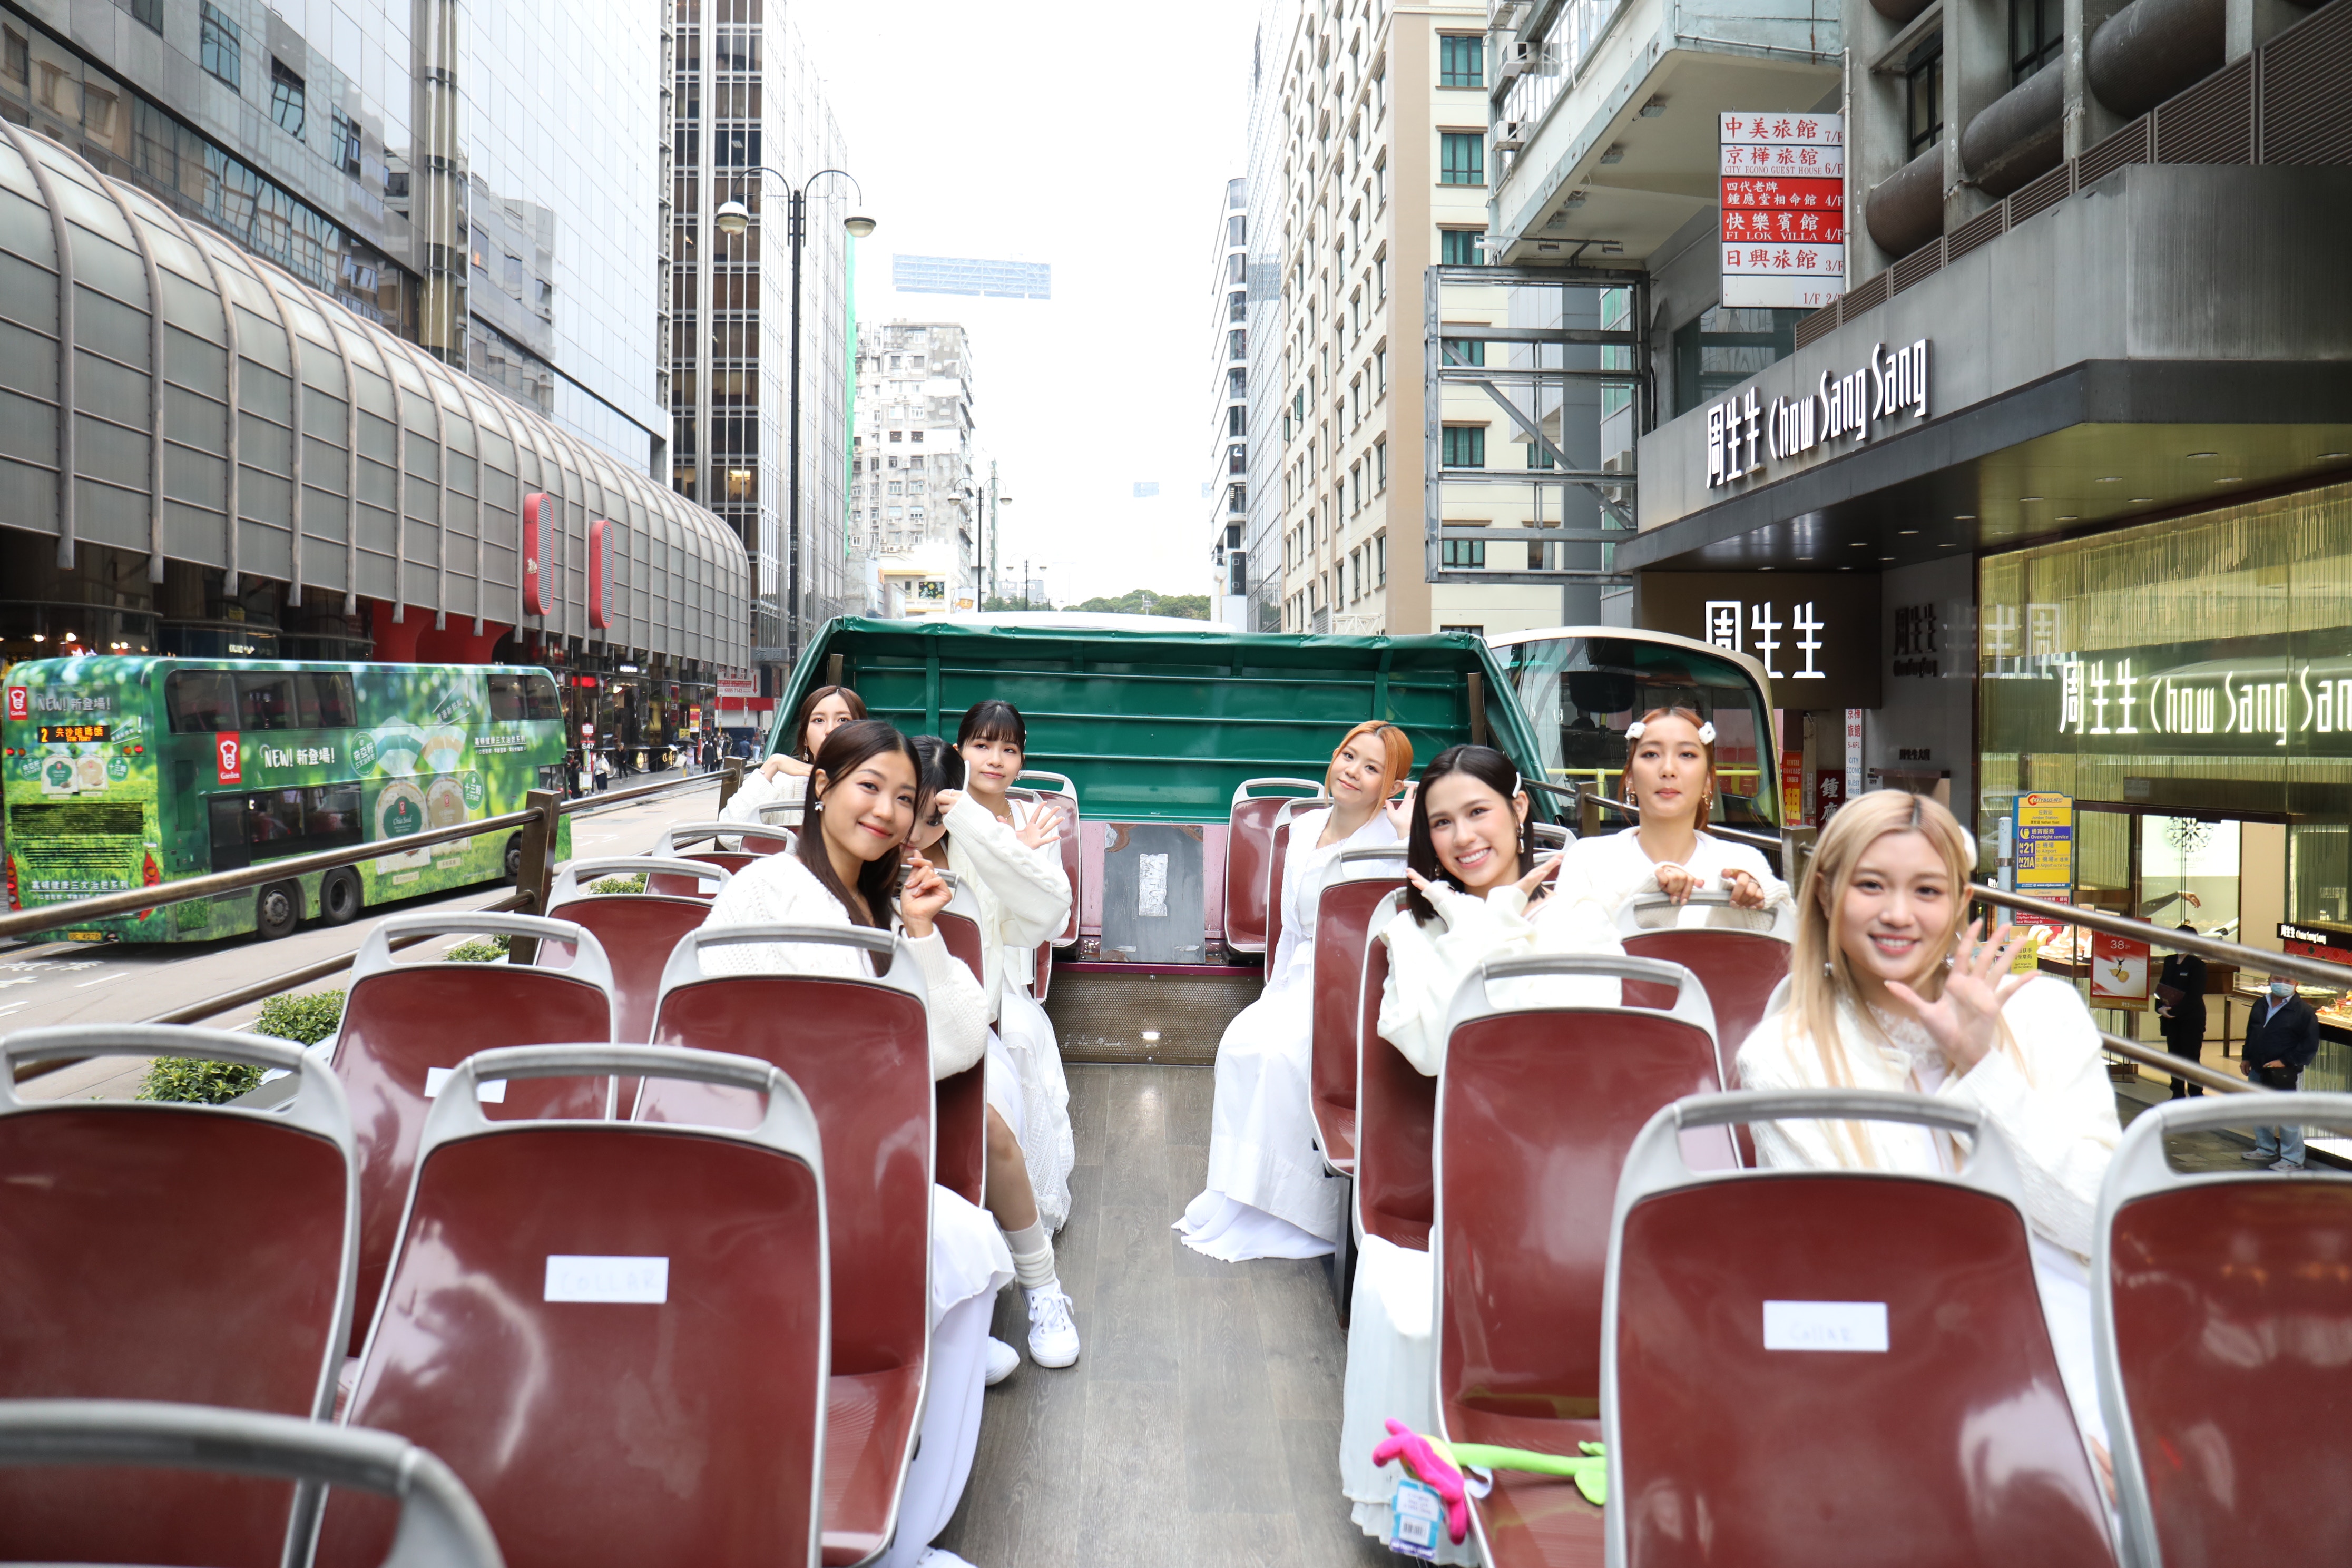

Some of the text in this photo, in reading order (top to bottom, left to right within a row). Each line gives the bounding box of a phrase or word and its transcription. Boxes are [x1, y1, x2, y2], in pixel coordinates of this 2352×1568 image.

[1724, 116, 1818, 140] 中美旅館
[1745, 166, 1768, 174] ECONO
[1799, 166, 1822, 175] HOUSE
[1726, 181, 1778, 193] 四代老牌
[1727, 193, 1817, 207] 鍾應堂相命館
[1726, 212, 1819, 232] 快樂賓館
[1746, 232, 1772, 240] LOK
[1780, 232, 1818, 241] VILLA
[1727, 249, 1818, 270] 日興旅館
[1804, 292, 1820, 305] 1/F
[1769, 339, 1929, 461] Chow Sang Sang
[1707, 386, 1762, 489] 周生生
[1706, 601, 1826, 679] 周生生
[38, 697, 67, 711] NEW!
[2059, 658, 2138, 734] 周生生
[2150, 665, 2352, 746] Chow Sang San
[41, 727, 49, 743] 2
[1847, 724, 1861, 738] 旅館
[264, 748, 293, 768] NEW!
[220, 771, 240, 780] Garden
[2280, 925, 2296, 938] 周生生
